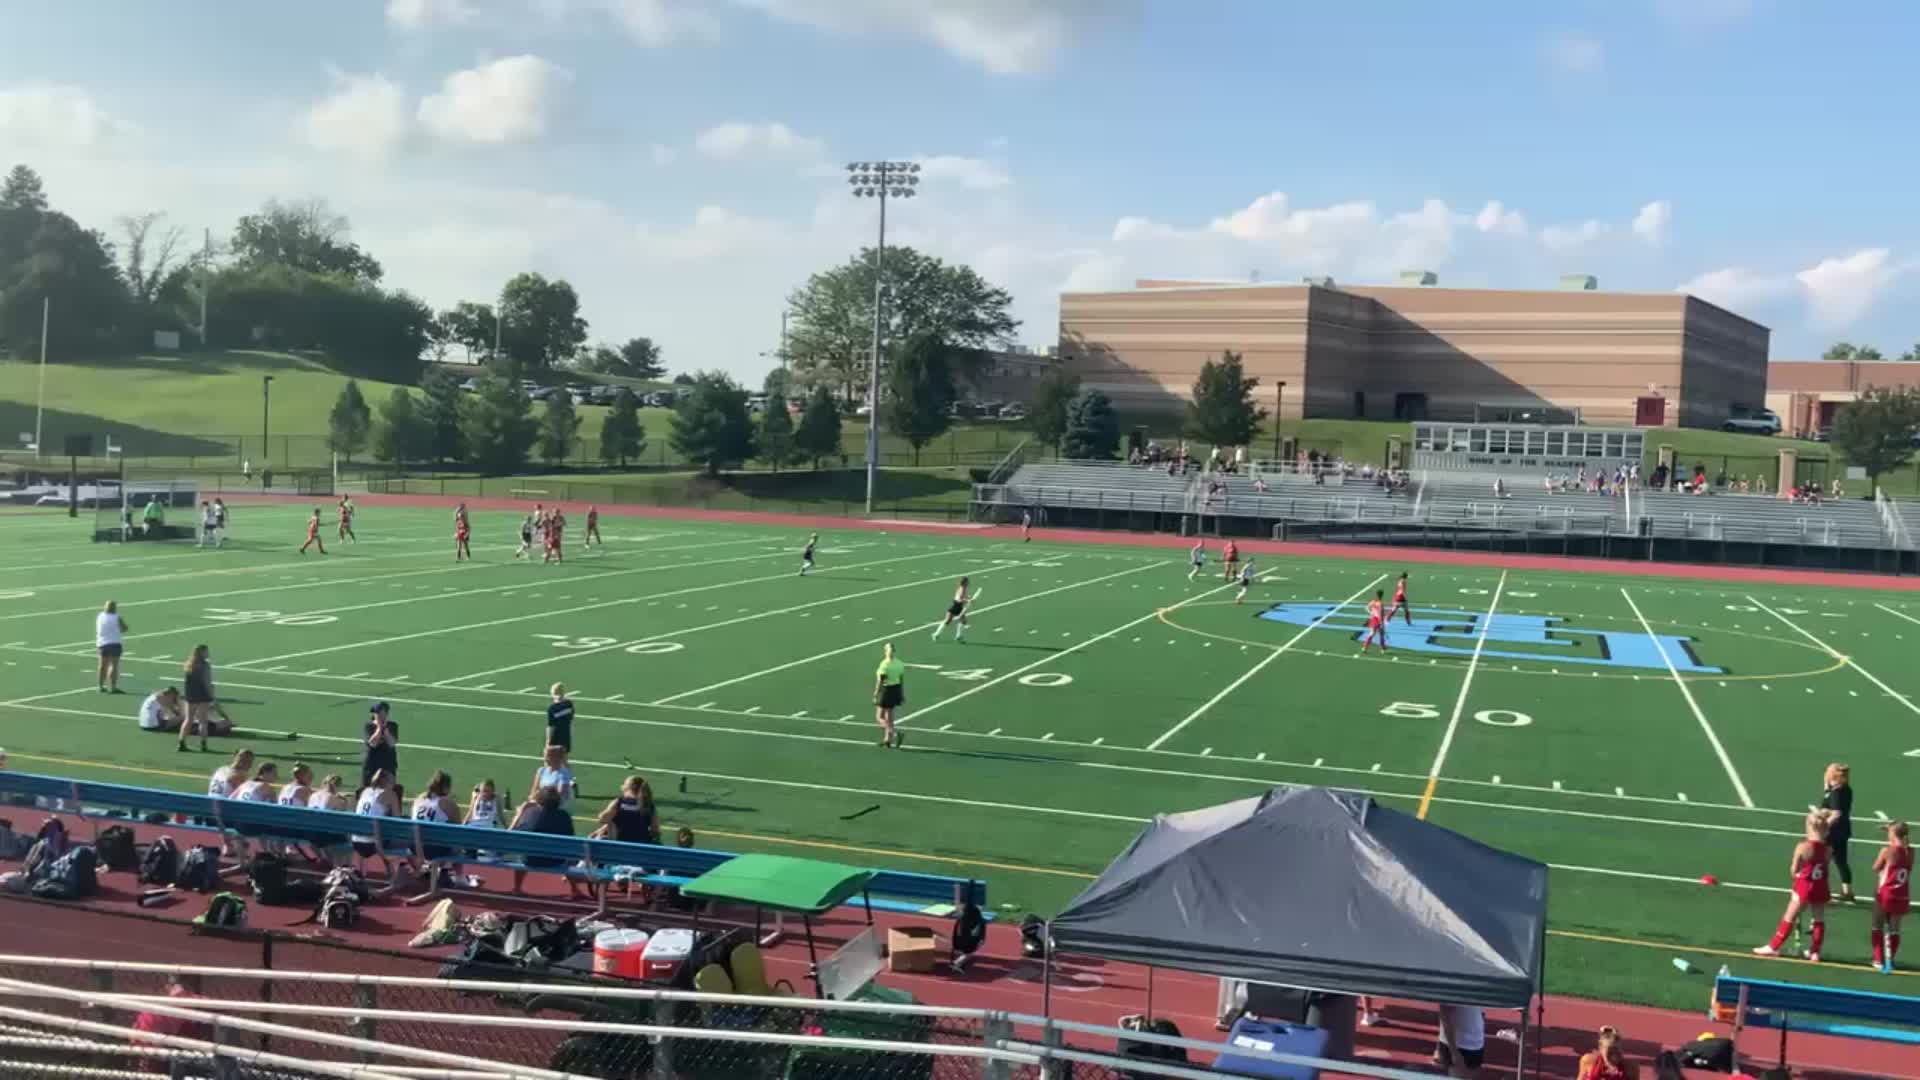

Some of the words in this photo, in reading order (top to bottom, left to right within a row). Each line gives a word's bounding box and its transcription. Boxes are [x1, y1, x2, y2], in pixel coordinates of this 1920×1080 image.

[937, 667, 1074, 687] 40
[1379, 701, 1533, 727] 50
[416, 806, 437, 821] 24
[1811, 863, 1824, 880] 6
